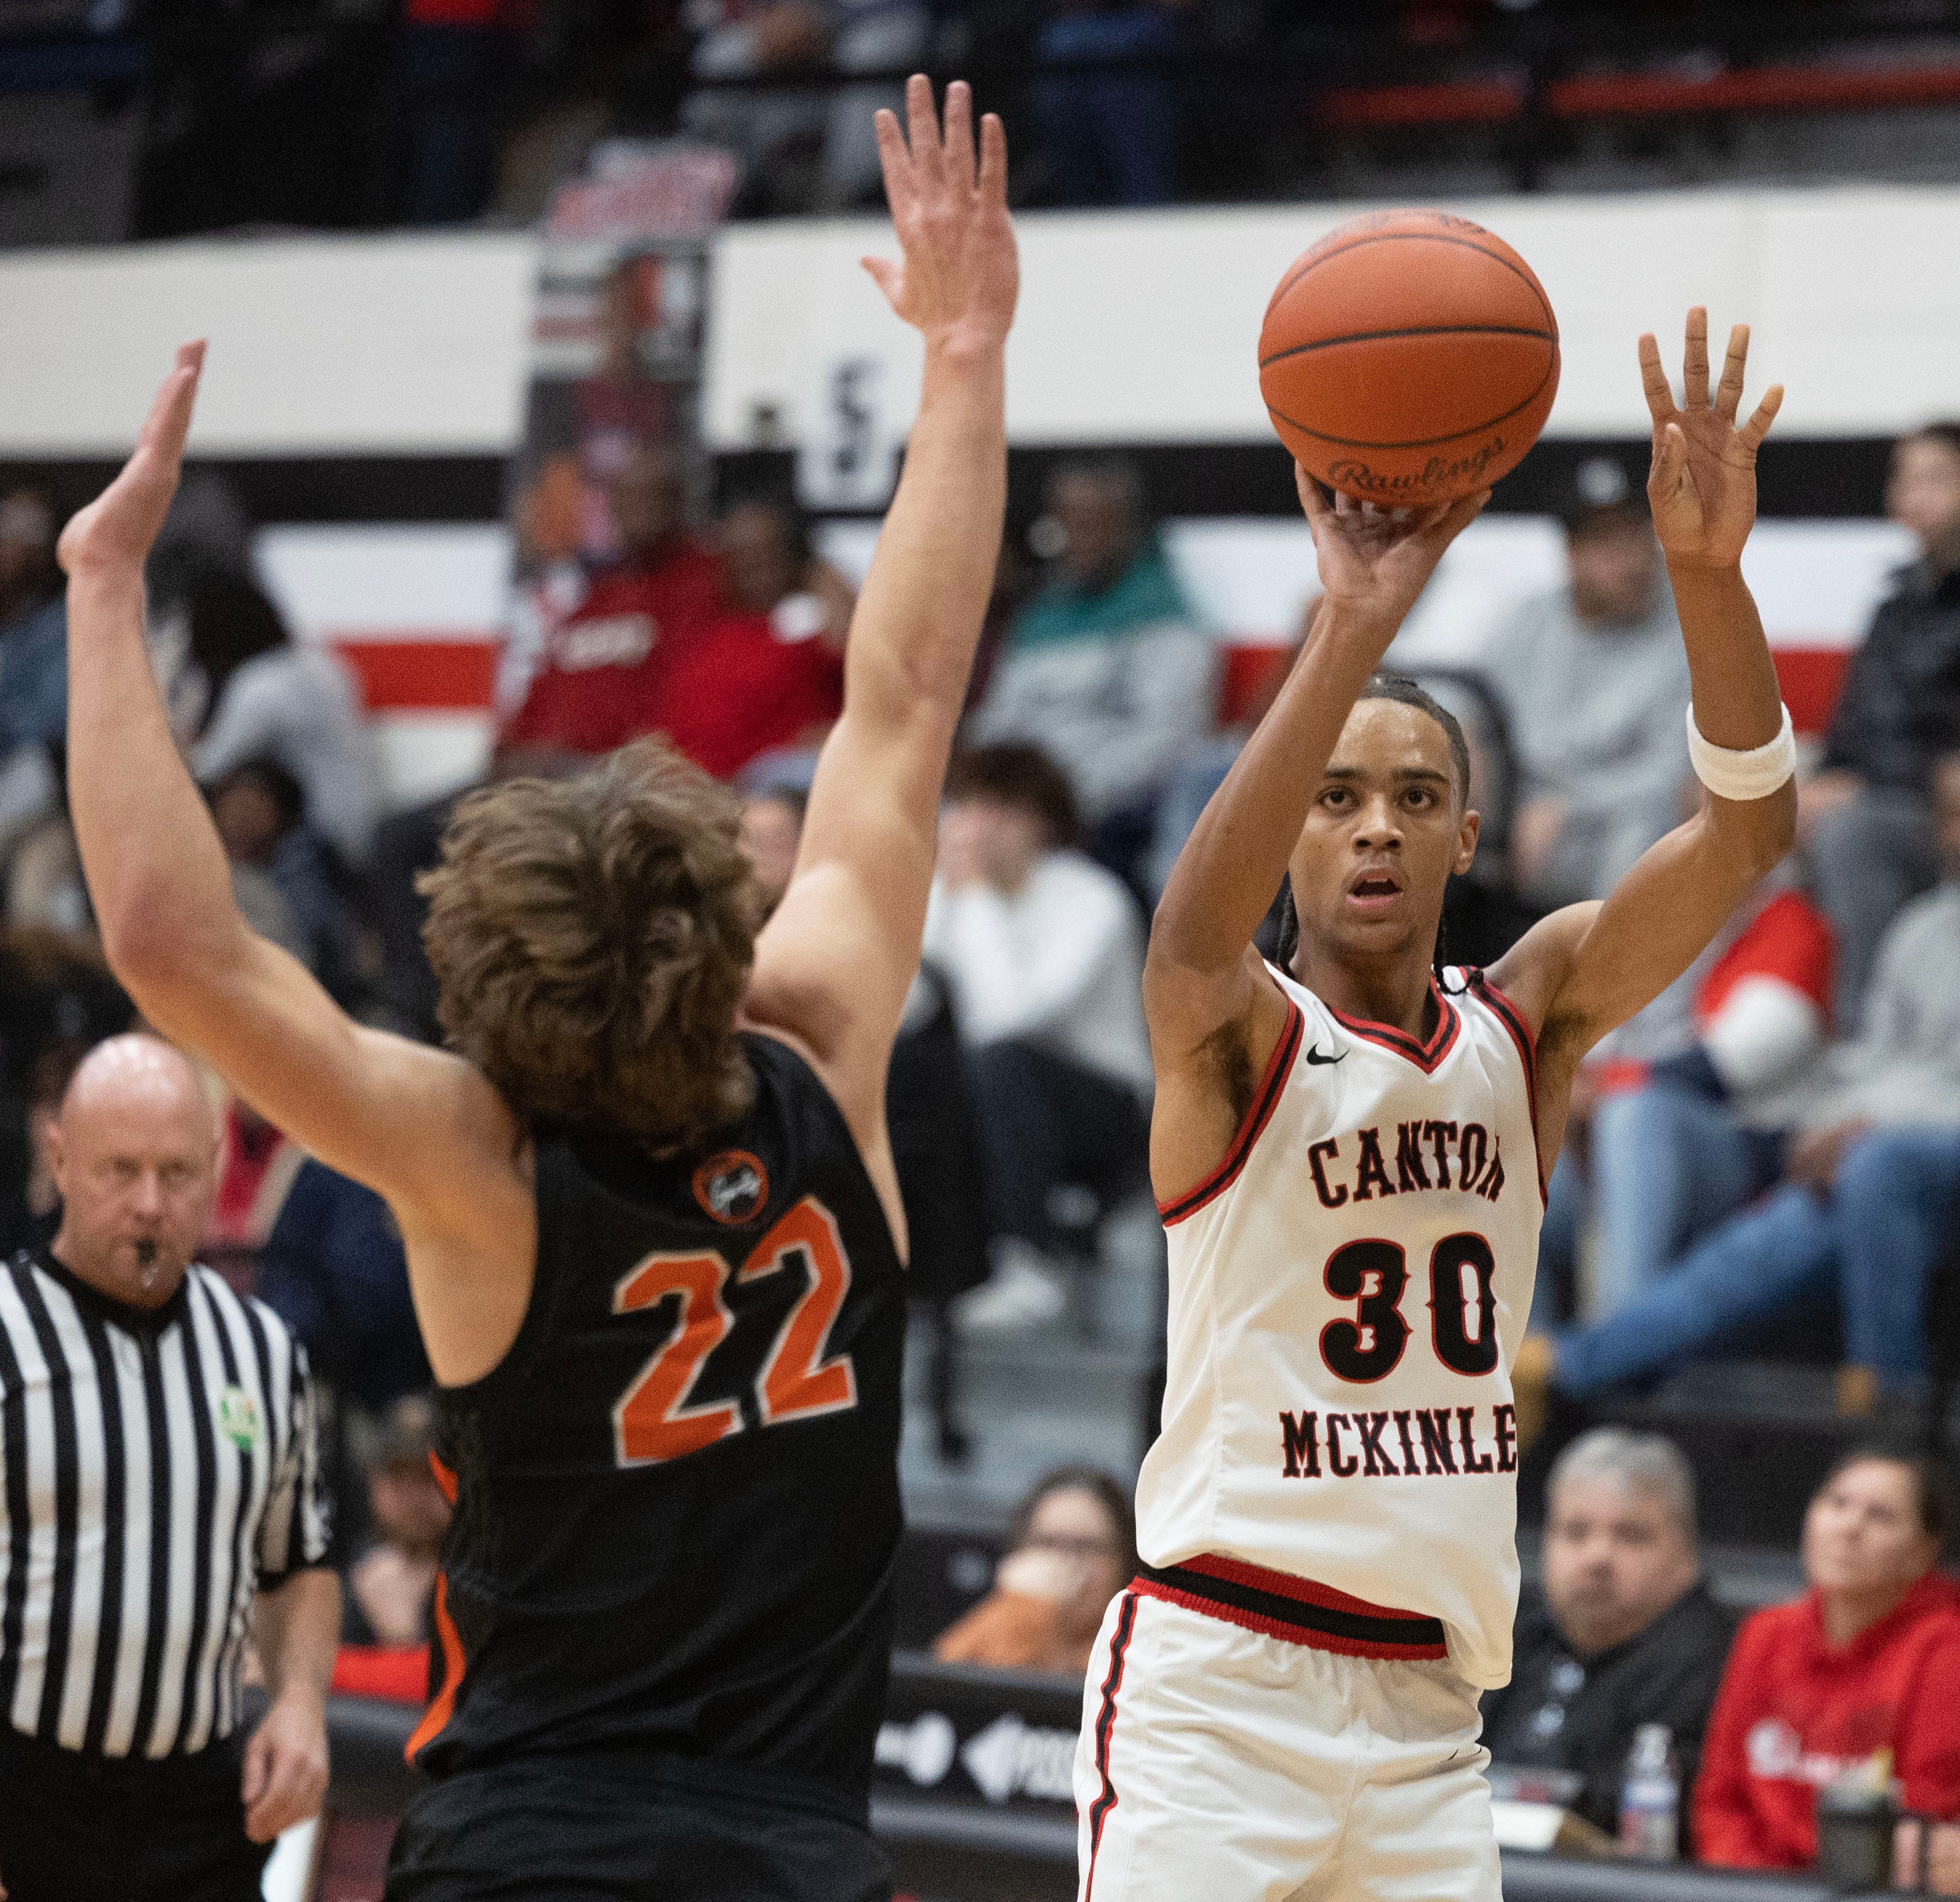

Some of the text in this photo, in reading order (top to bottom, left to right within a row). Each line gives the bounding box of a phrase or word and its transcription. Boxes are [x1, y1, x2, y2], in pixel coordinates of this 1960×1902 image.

[1328, 436, 1504, 490] Rawlings
[611, 1194, 858, 1469] 22
[1318, 1232, 1497, 1384] 30
